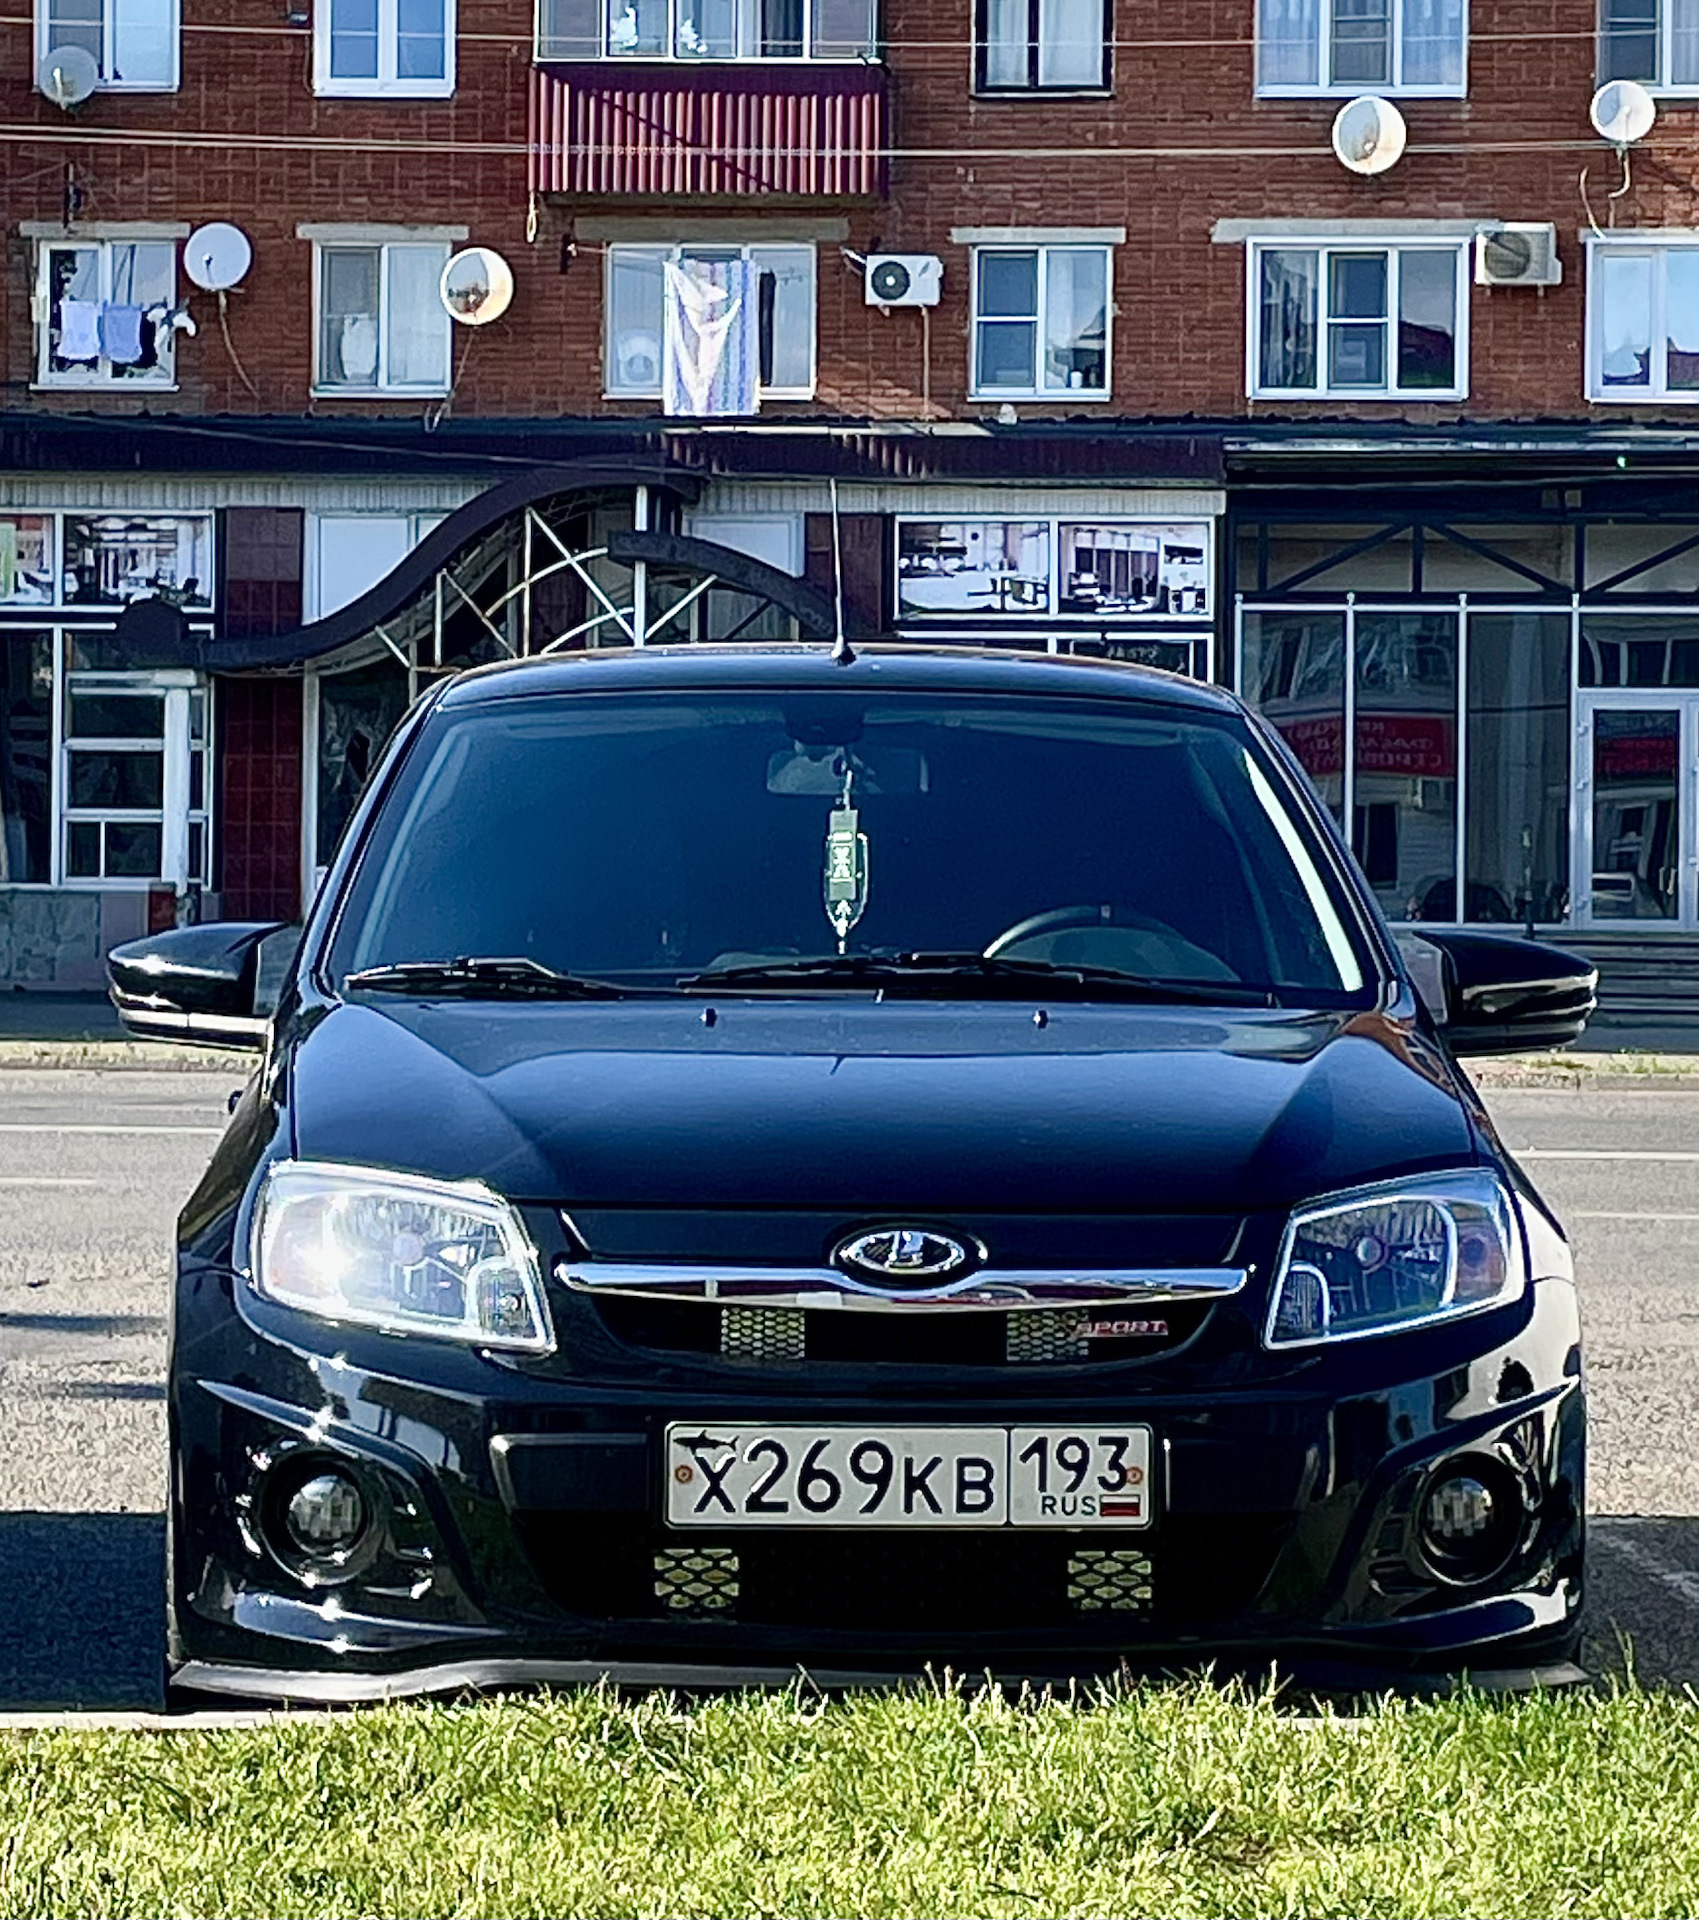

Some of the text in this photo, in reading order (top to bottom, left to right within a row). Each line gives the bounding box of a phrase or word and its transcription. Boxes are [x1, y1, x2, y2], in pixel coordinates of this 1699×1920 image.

[1075, 1320, 1167, 1334] SPORT
[693, 1436, 1130, 1515] Х269КВ 193
[1040, 1495, 1097, 1516] RUS
